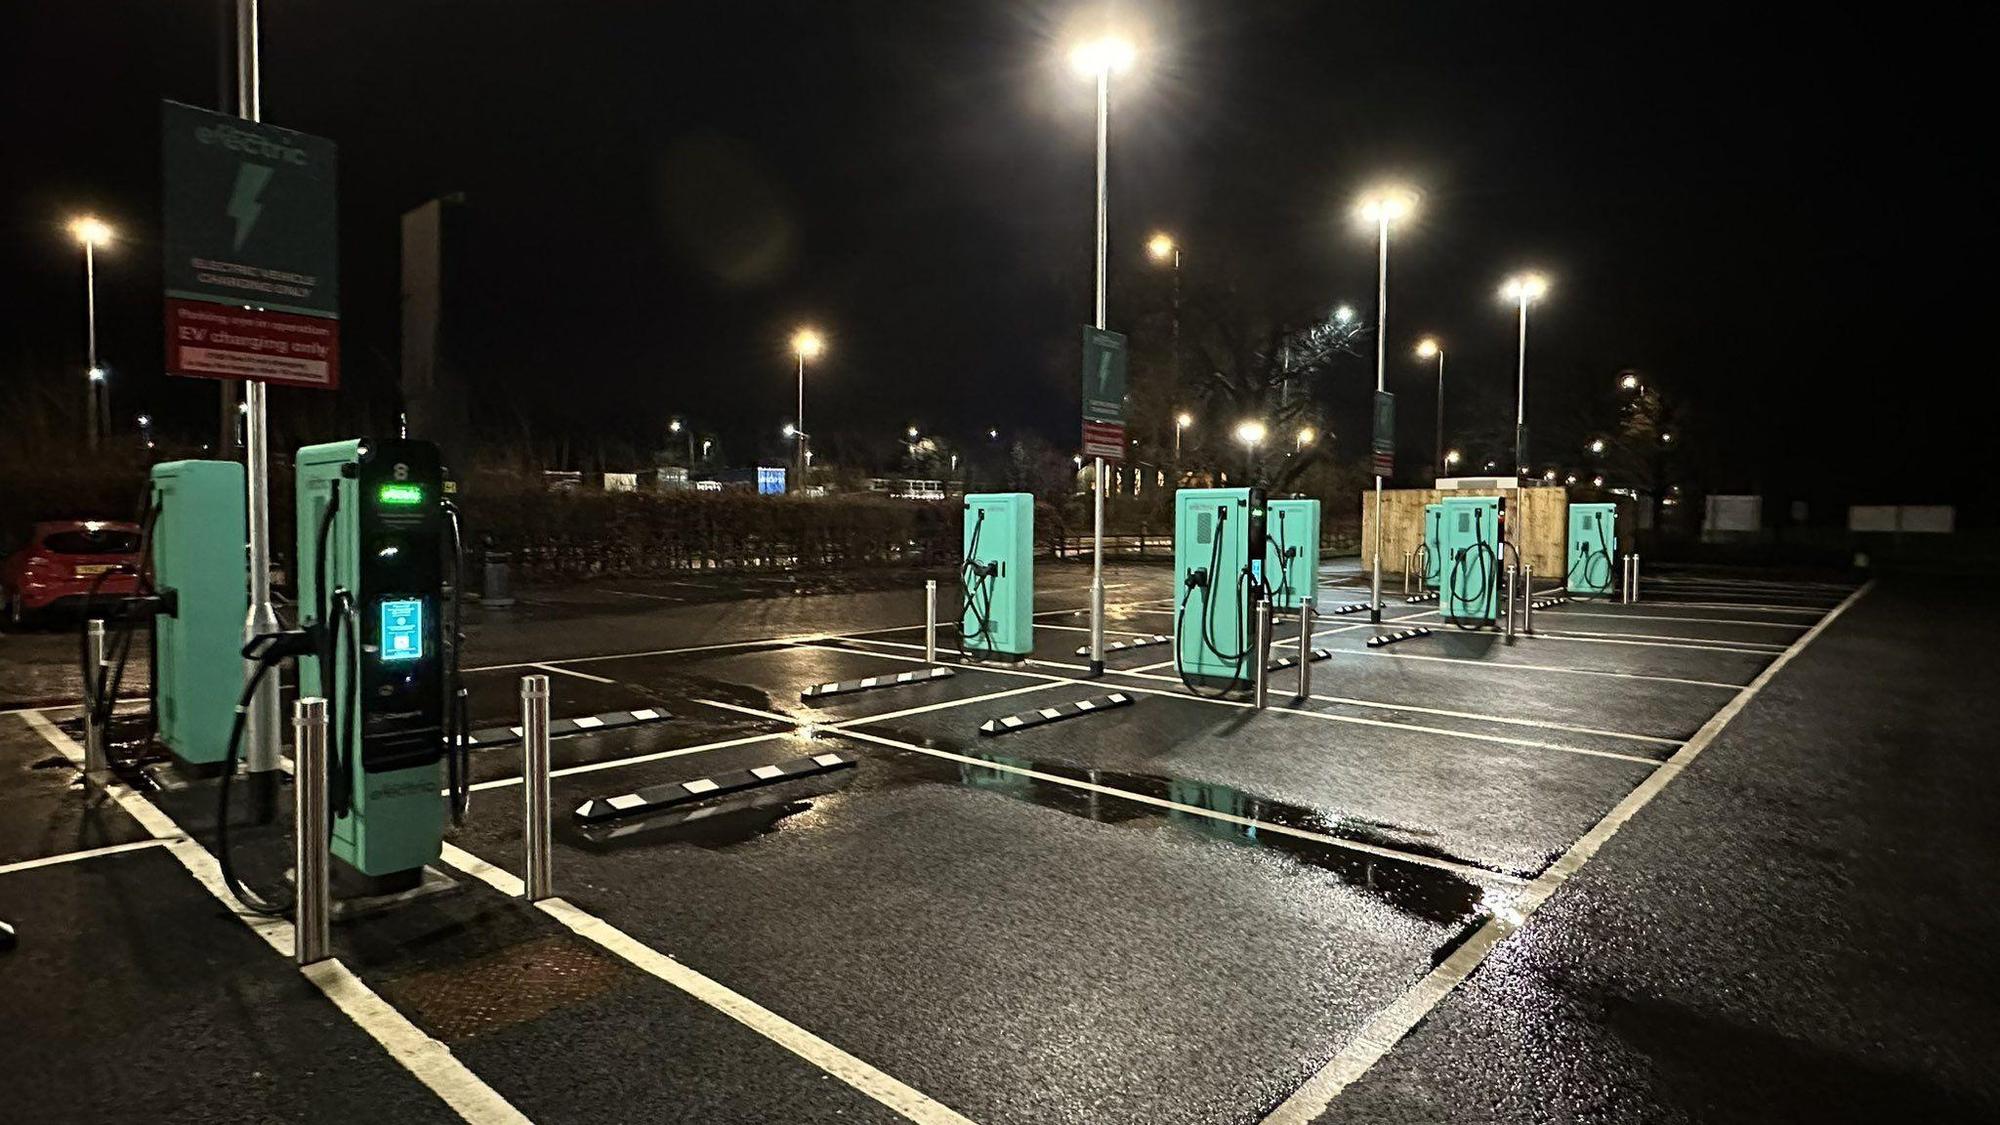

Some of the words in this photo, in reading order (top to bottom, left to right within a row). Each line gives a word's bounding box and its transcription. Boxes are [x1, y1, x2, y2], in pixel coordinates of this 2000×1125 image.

[177, 325, 207, 341] EV
[209, 330, 288, 353] charging
[290, 341, 328, 358] only
